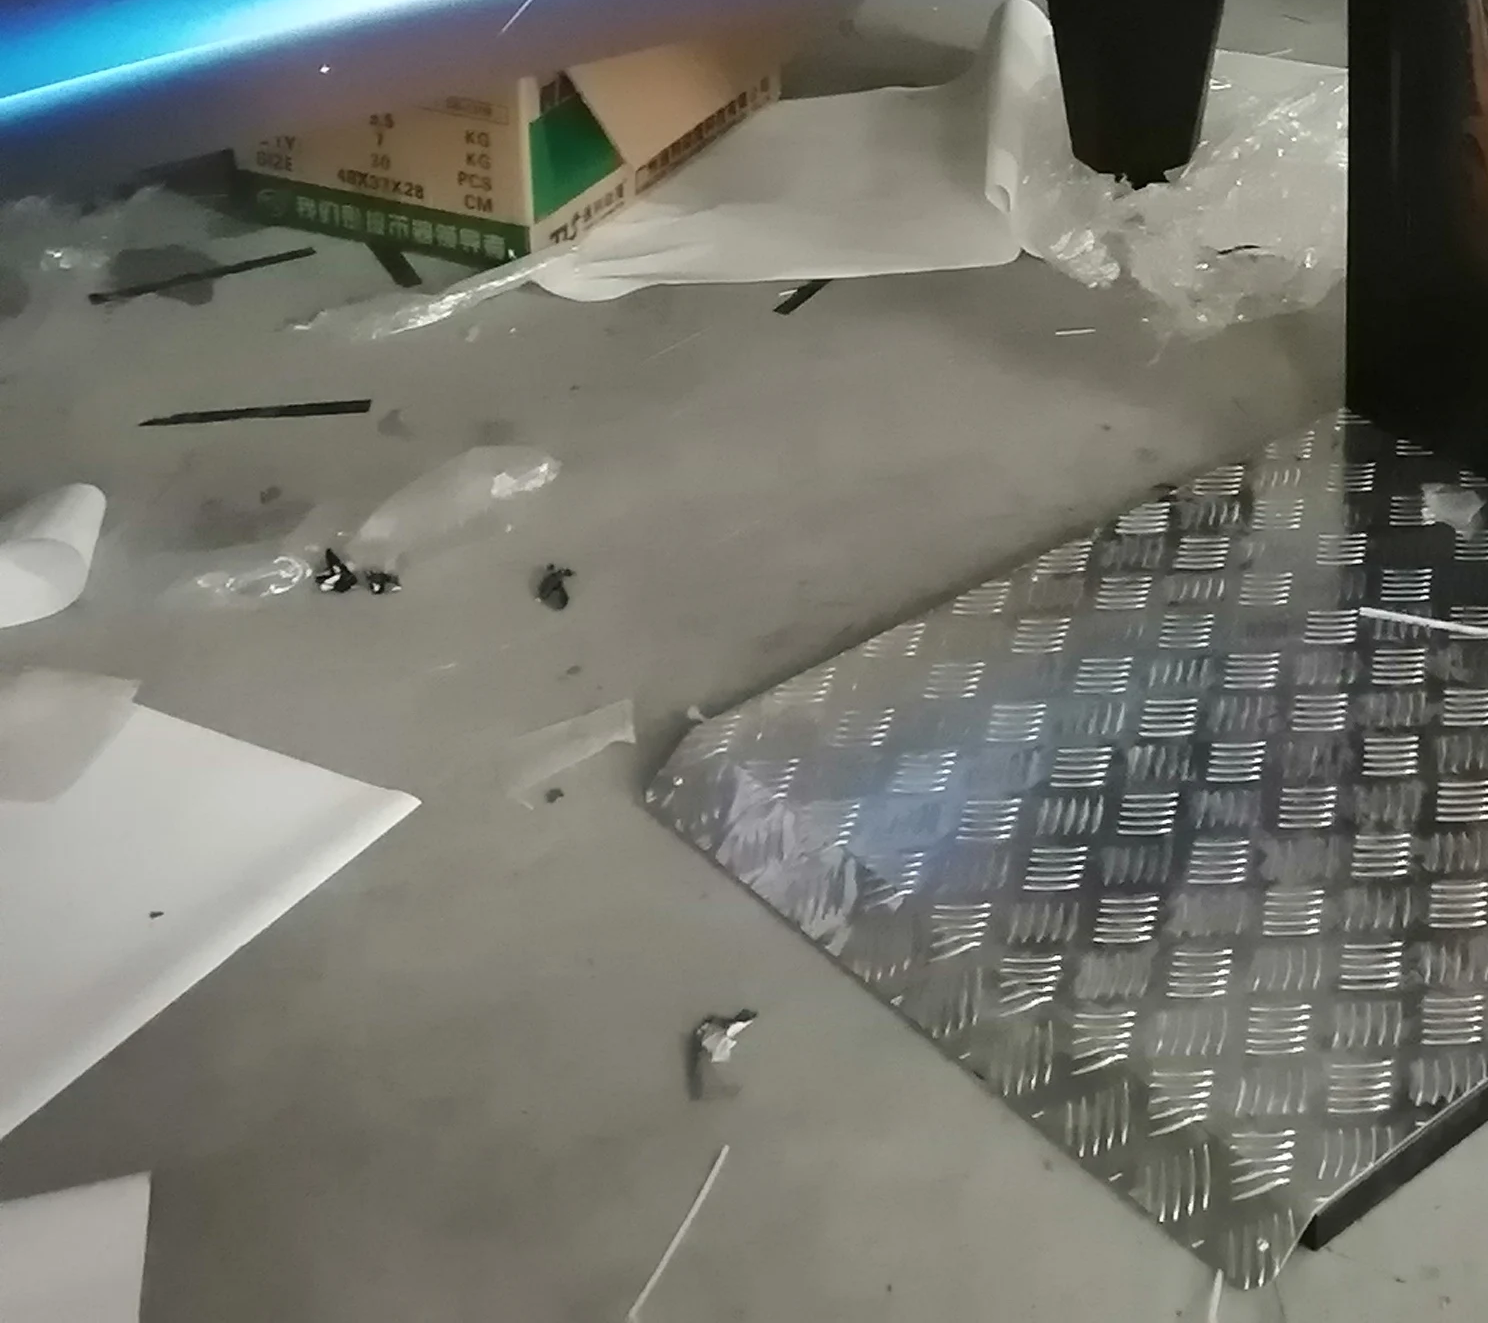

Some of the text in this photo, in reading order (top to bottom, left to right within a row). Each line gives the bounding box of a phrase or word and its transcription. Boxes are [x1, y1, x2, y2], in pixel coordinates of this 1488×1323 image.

[464, 129, 491, 149] KG
[465, 153, 492, 171] KG
[456, 170, 493, 192] PCS
[463, 193, 494, 214] CM
